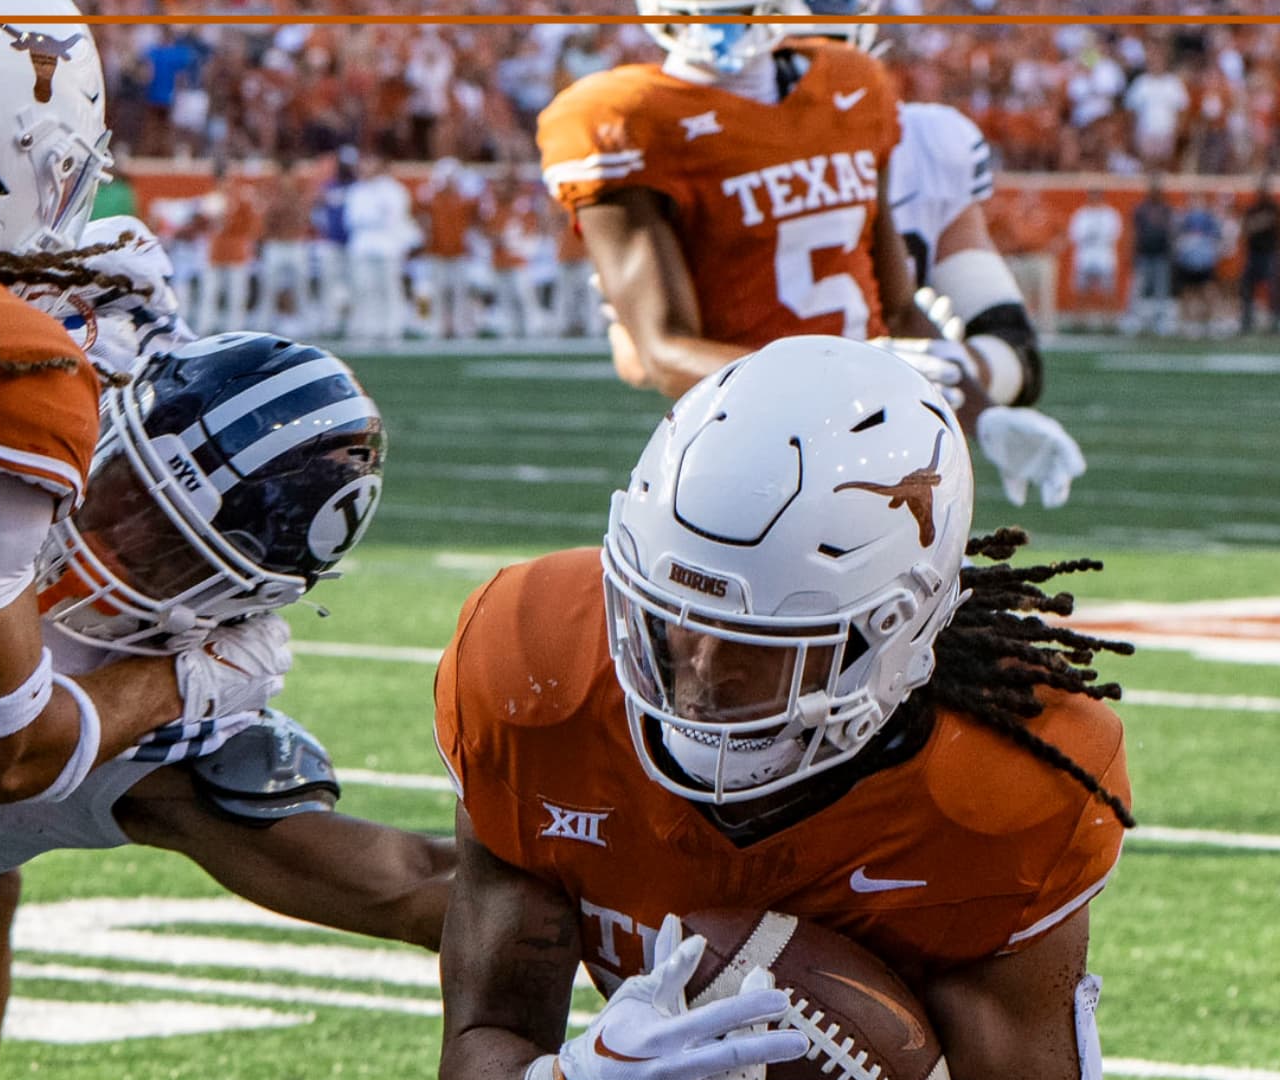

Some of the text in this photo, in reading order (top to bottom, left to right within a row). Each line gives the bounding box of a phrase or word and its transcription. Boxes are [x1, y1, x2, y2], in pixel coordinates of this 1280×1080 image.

[722, 150, 878, 227] TEXAS
[775, 205, 870, 341] 5
[168, 453, 202, 493] BYU
[669, 562, 729, 598] HORNS
[540, 801, 609, 847] XII
